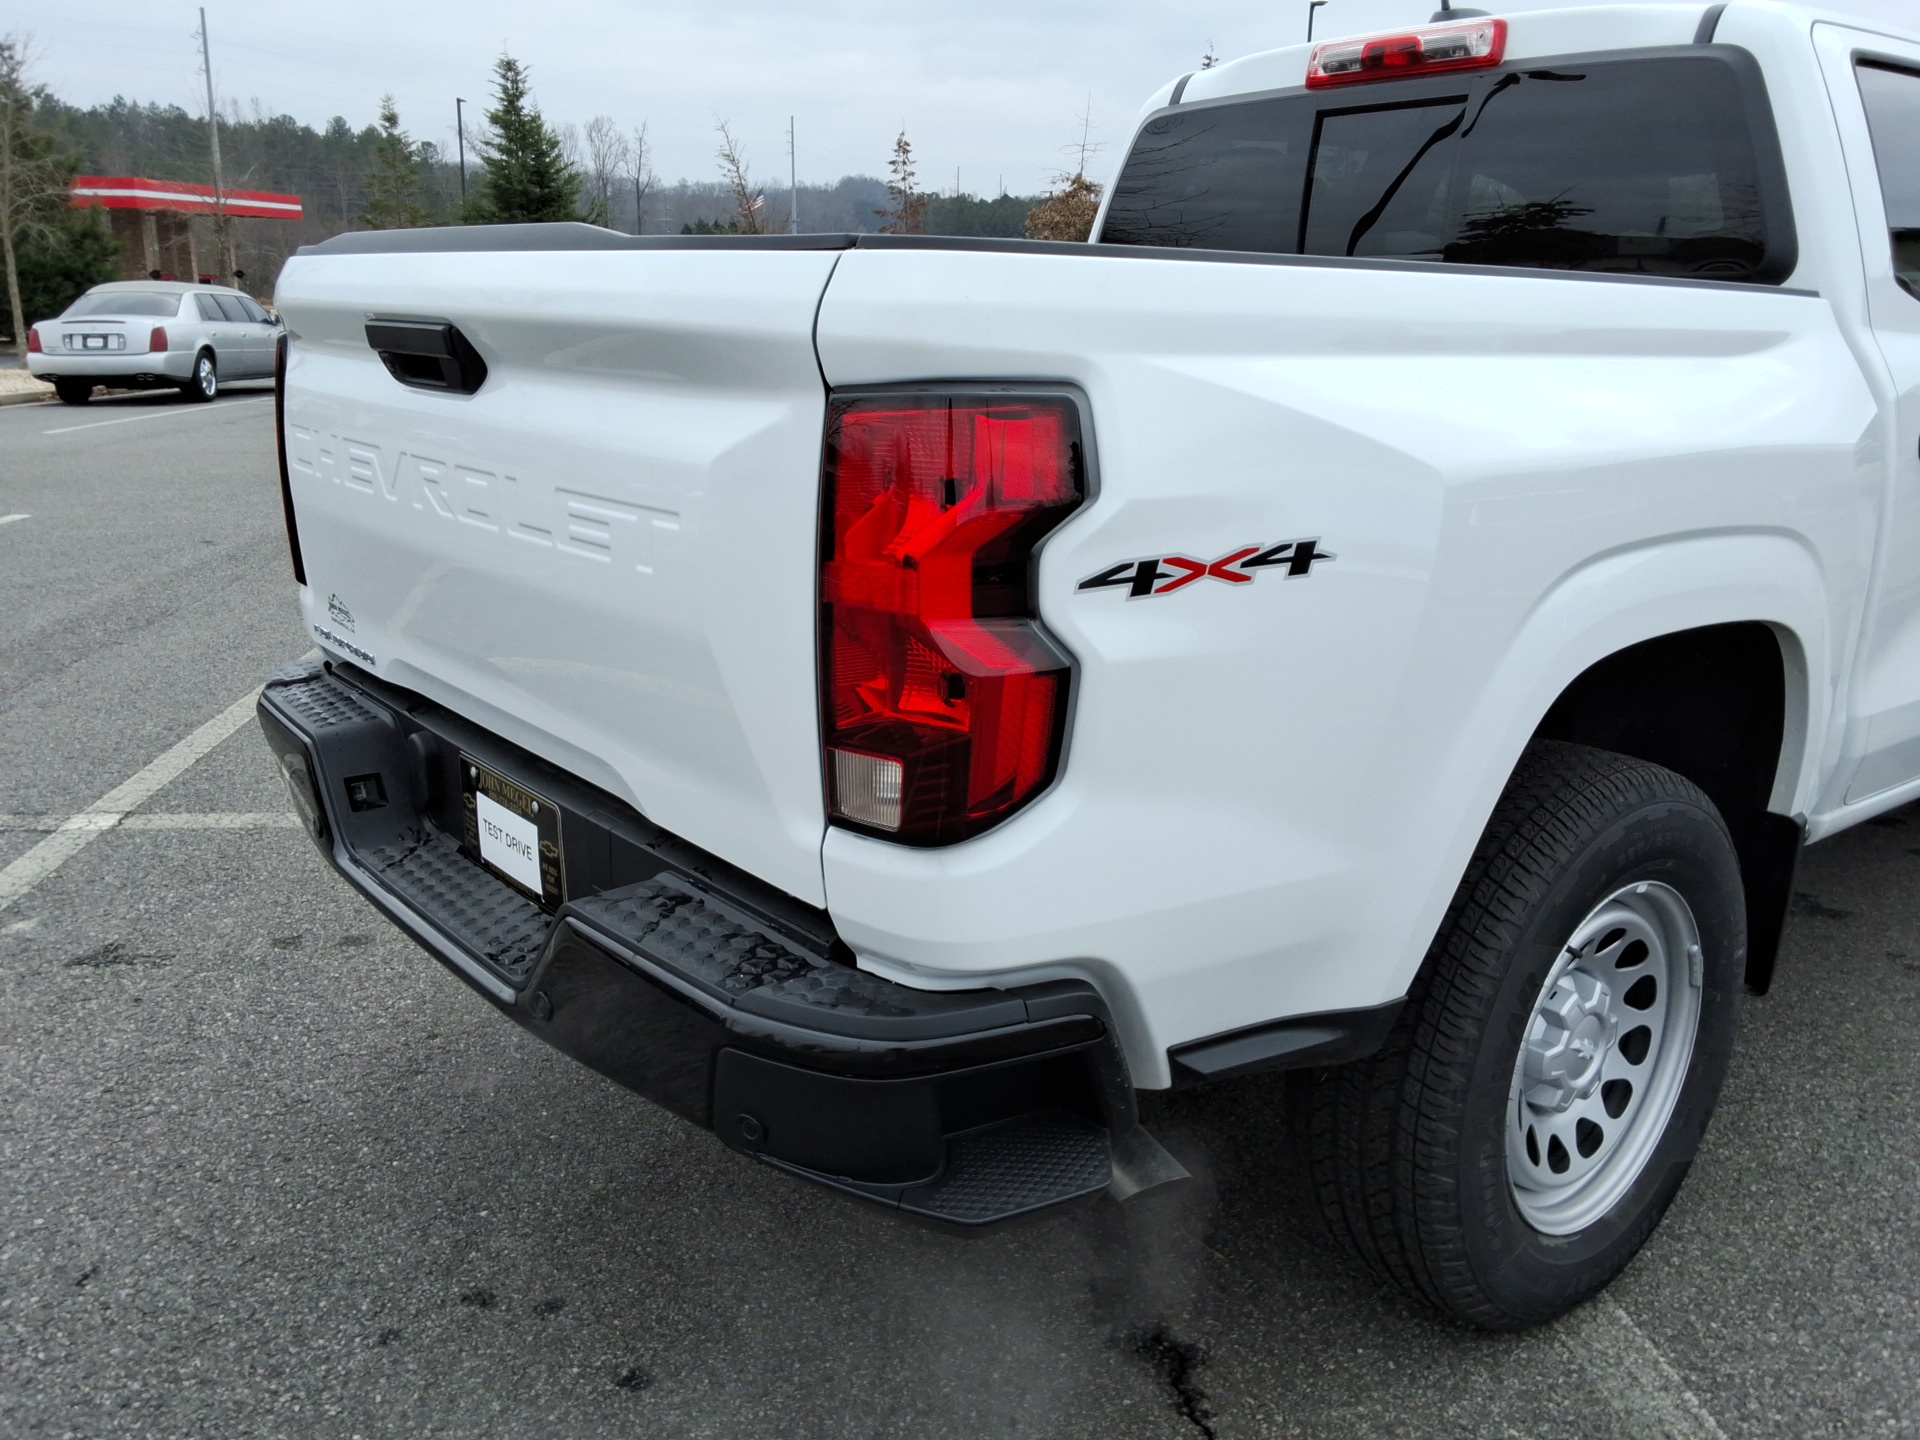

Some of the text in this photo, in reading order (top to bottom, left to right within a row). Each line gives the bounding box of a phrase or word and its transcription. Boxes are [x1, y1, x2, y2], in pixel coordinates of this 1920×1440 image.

[290, 423, 681, 576] CHEVROLET
[478, 769, 536, 818] JOHN MEGEL
[482, 818, 504, 843] TEST
[505, 834, 533, 862] DRIVE
